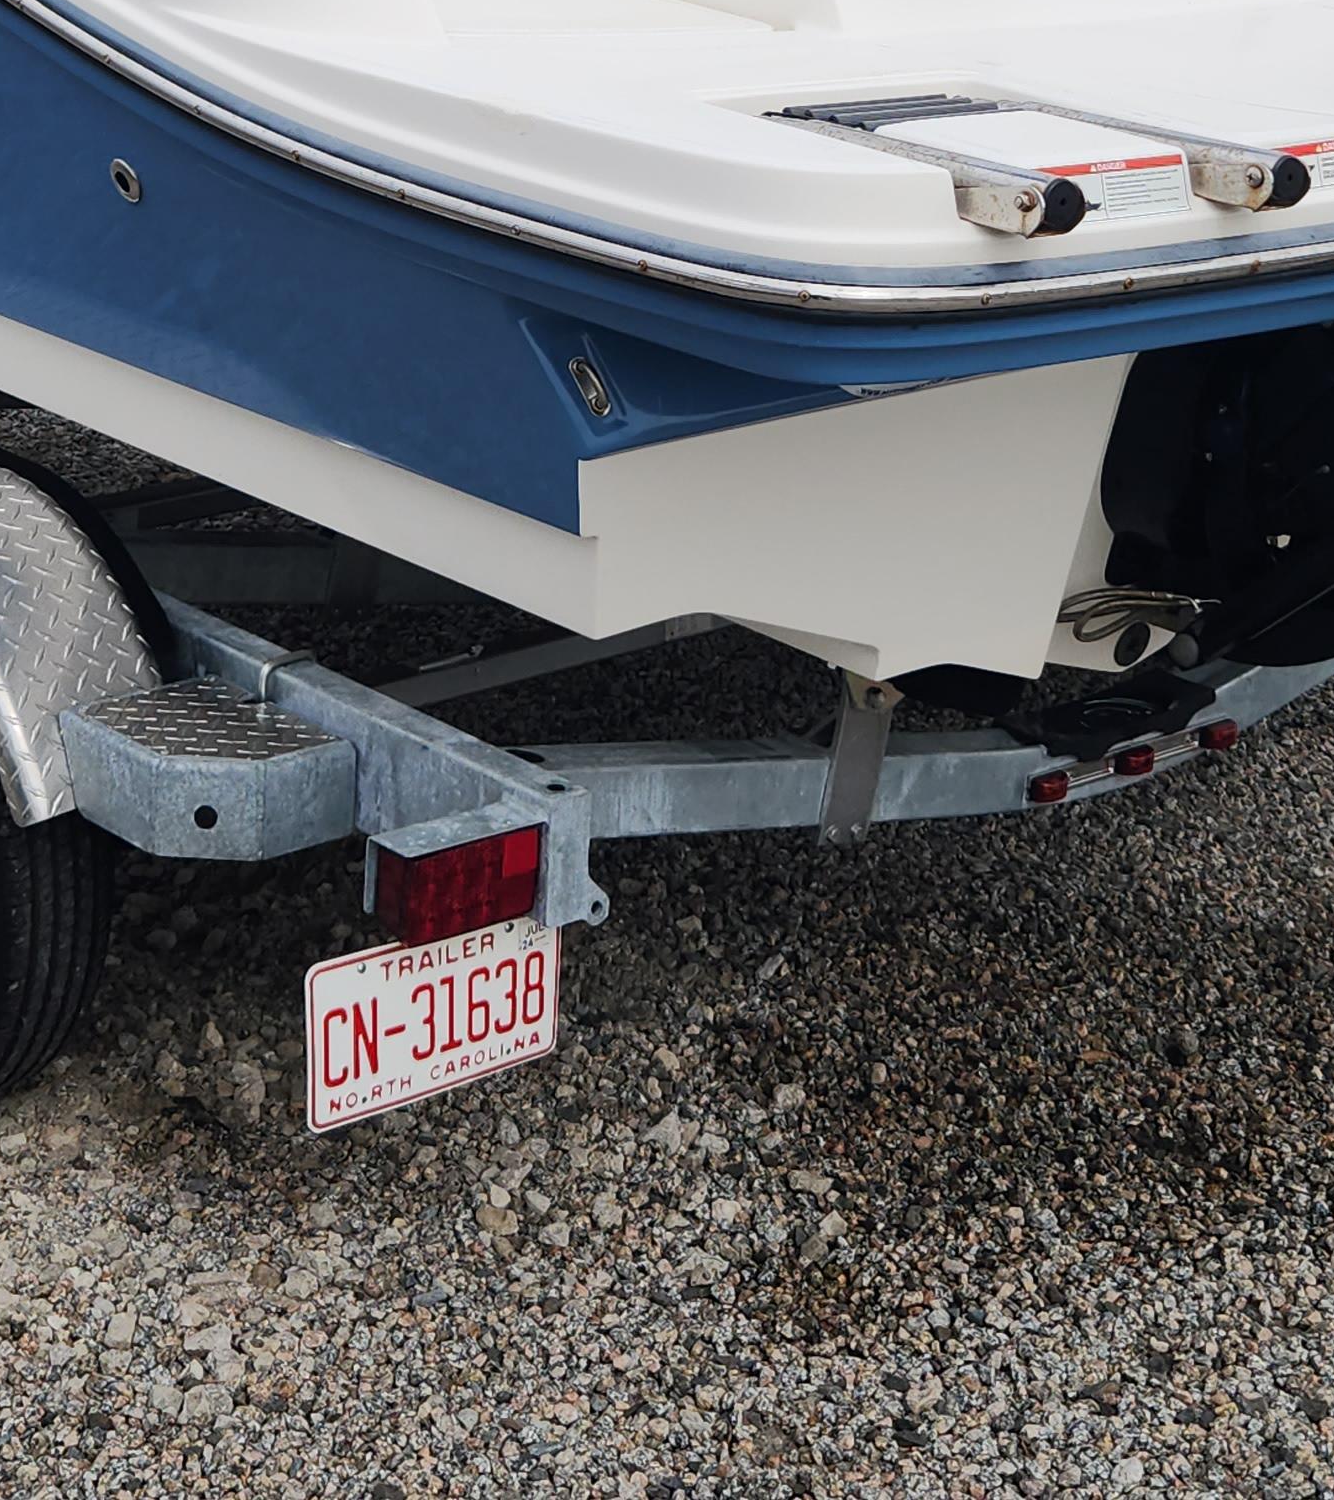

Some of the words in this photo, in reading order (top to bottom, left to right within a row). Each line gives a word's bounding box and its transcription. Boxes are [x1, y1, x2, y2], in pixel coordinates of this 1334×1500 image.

[380, 931, 495, 982] TRAILER
[323, 950, 545, 1089] CN-31638
[329, 1075, 412, 1115] NORTH
[430, 1031, 541, 1081] CAROLINA
